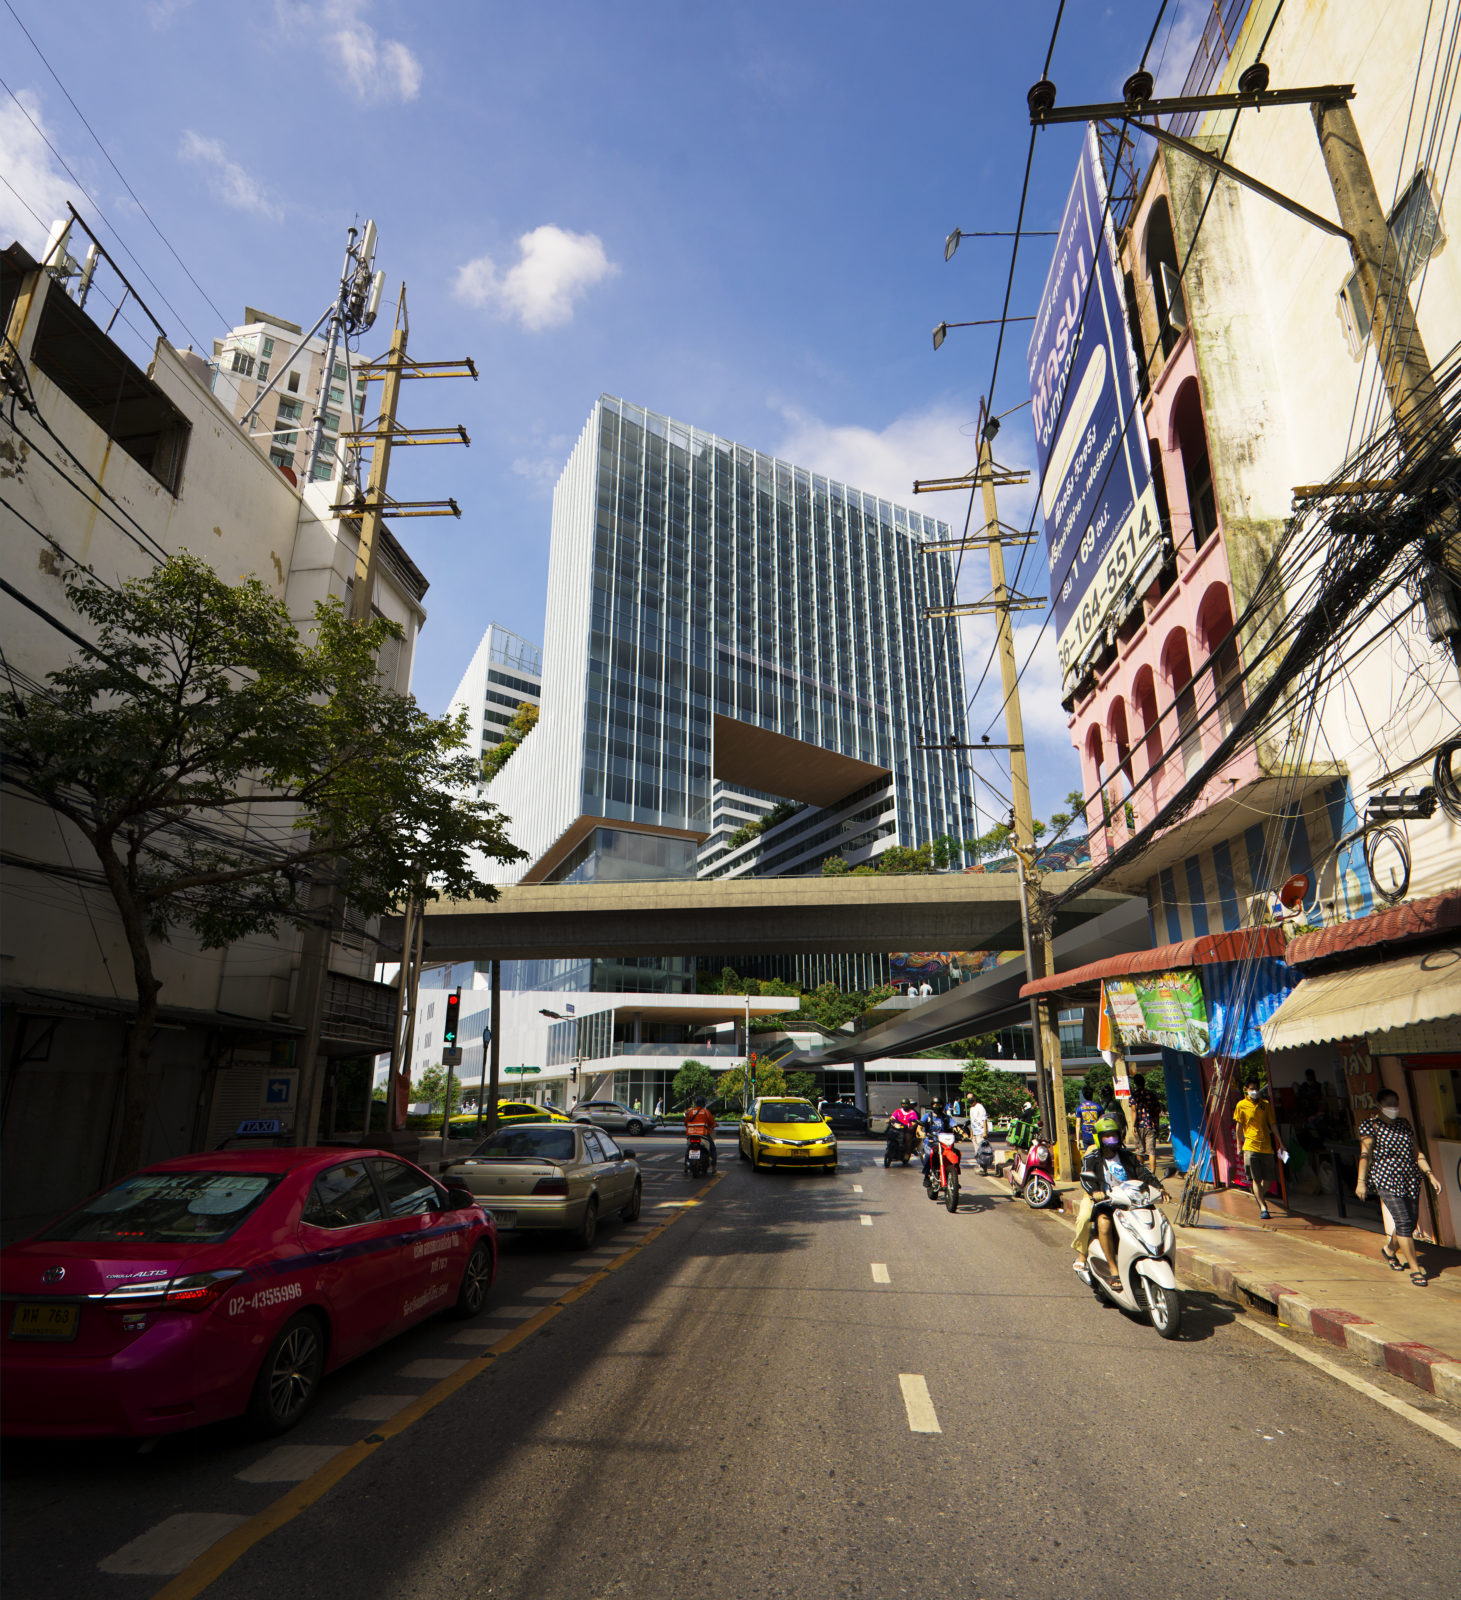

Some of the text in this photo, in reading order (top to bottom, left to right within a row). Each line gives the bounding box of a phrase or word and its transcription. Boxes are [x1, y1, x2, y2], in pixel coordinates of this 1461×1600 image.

[1032, 243, 1088, 442] ให้ครบ!
[246, 1122, 274, 1132] TAXI
[132, 1270, 168, 1278] ALTIS
[228, 1282, 302, 1316] 02-4355996
[48, 1308, 70, 1323] 763
